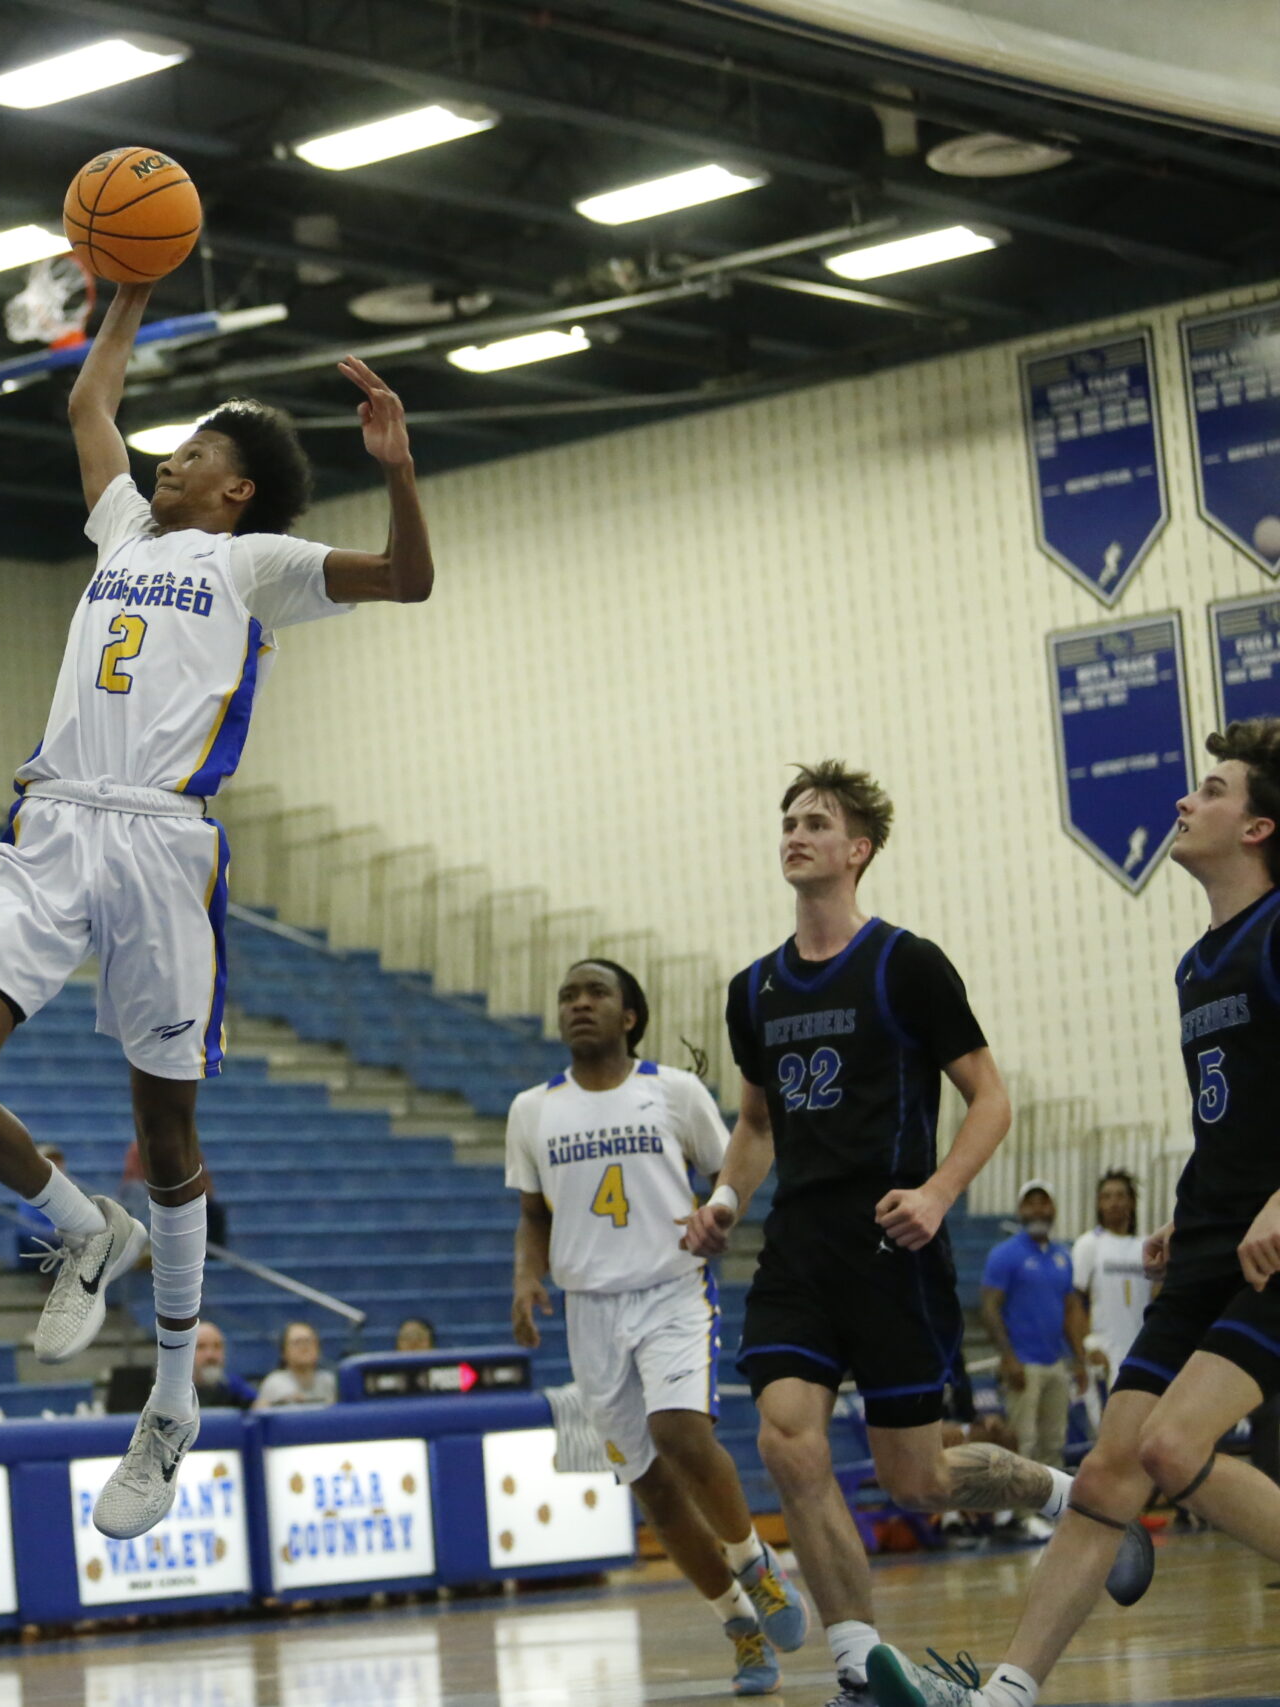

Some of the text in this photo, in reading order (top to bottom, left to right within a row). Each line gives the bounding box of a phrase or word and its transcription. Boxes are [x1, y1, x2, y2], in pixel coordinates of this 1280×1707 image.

[130, 154, 173, 180] NCA
[95, 613, 148, 695] 2
[764, 1008, 856, 1047] DEFENDERS
[1181, 993, 1251, 1046] EFENDERS
[778, 1047, 842, 1112] 22
[1198, 1046, 1229, 1124] 5
[547, 1125, 660, 1148] UNIVERSAL
[549, 1136, 664, 1168] AUDENRIED
[590, 1163, 630, 1229] 4
[80, 1479, 234, 1528] PANT
[314, 1472, 383, 1511] BEAR
[105, 1529, 216, 1576] VALLEY
[289, 1513, 412, 1560] COUNTRY
